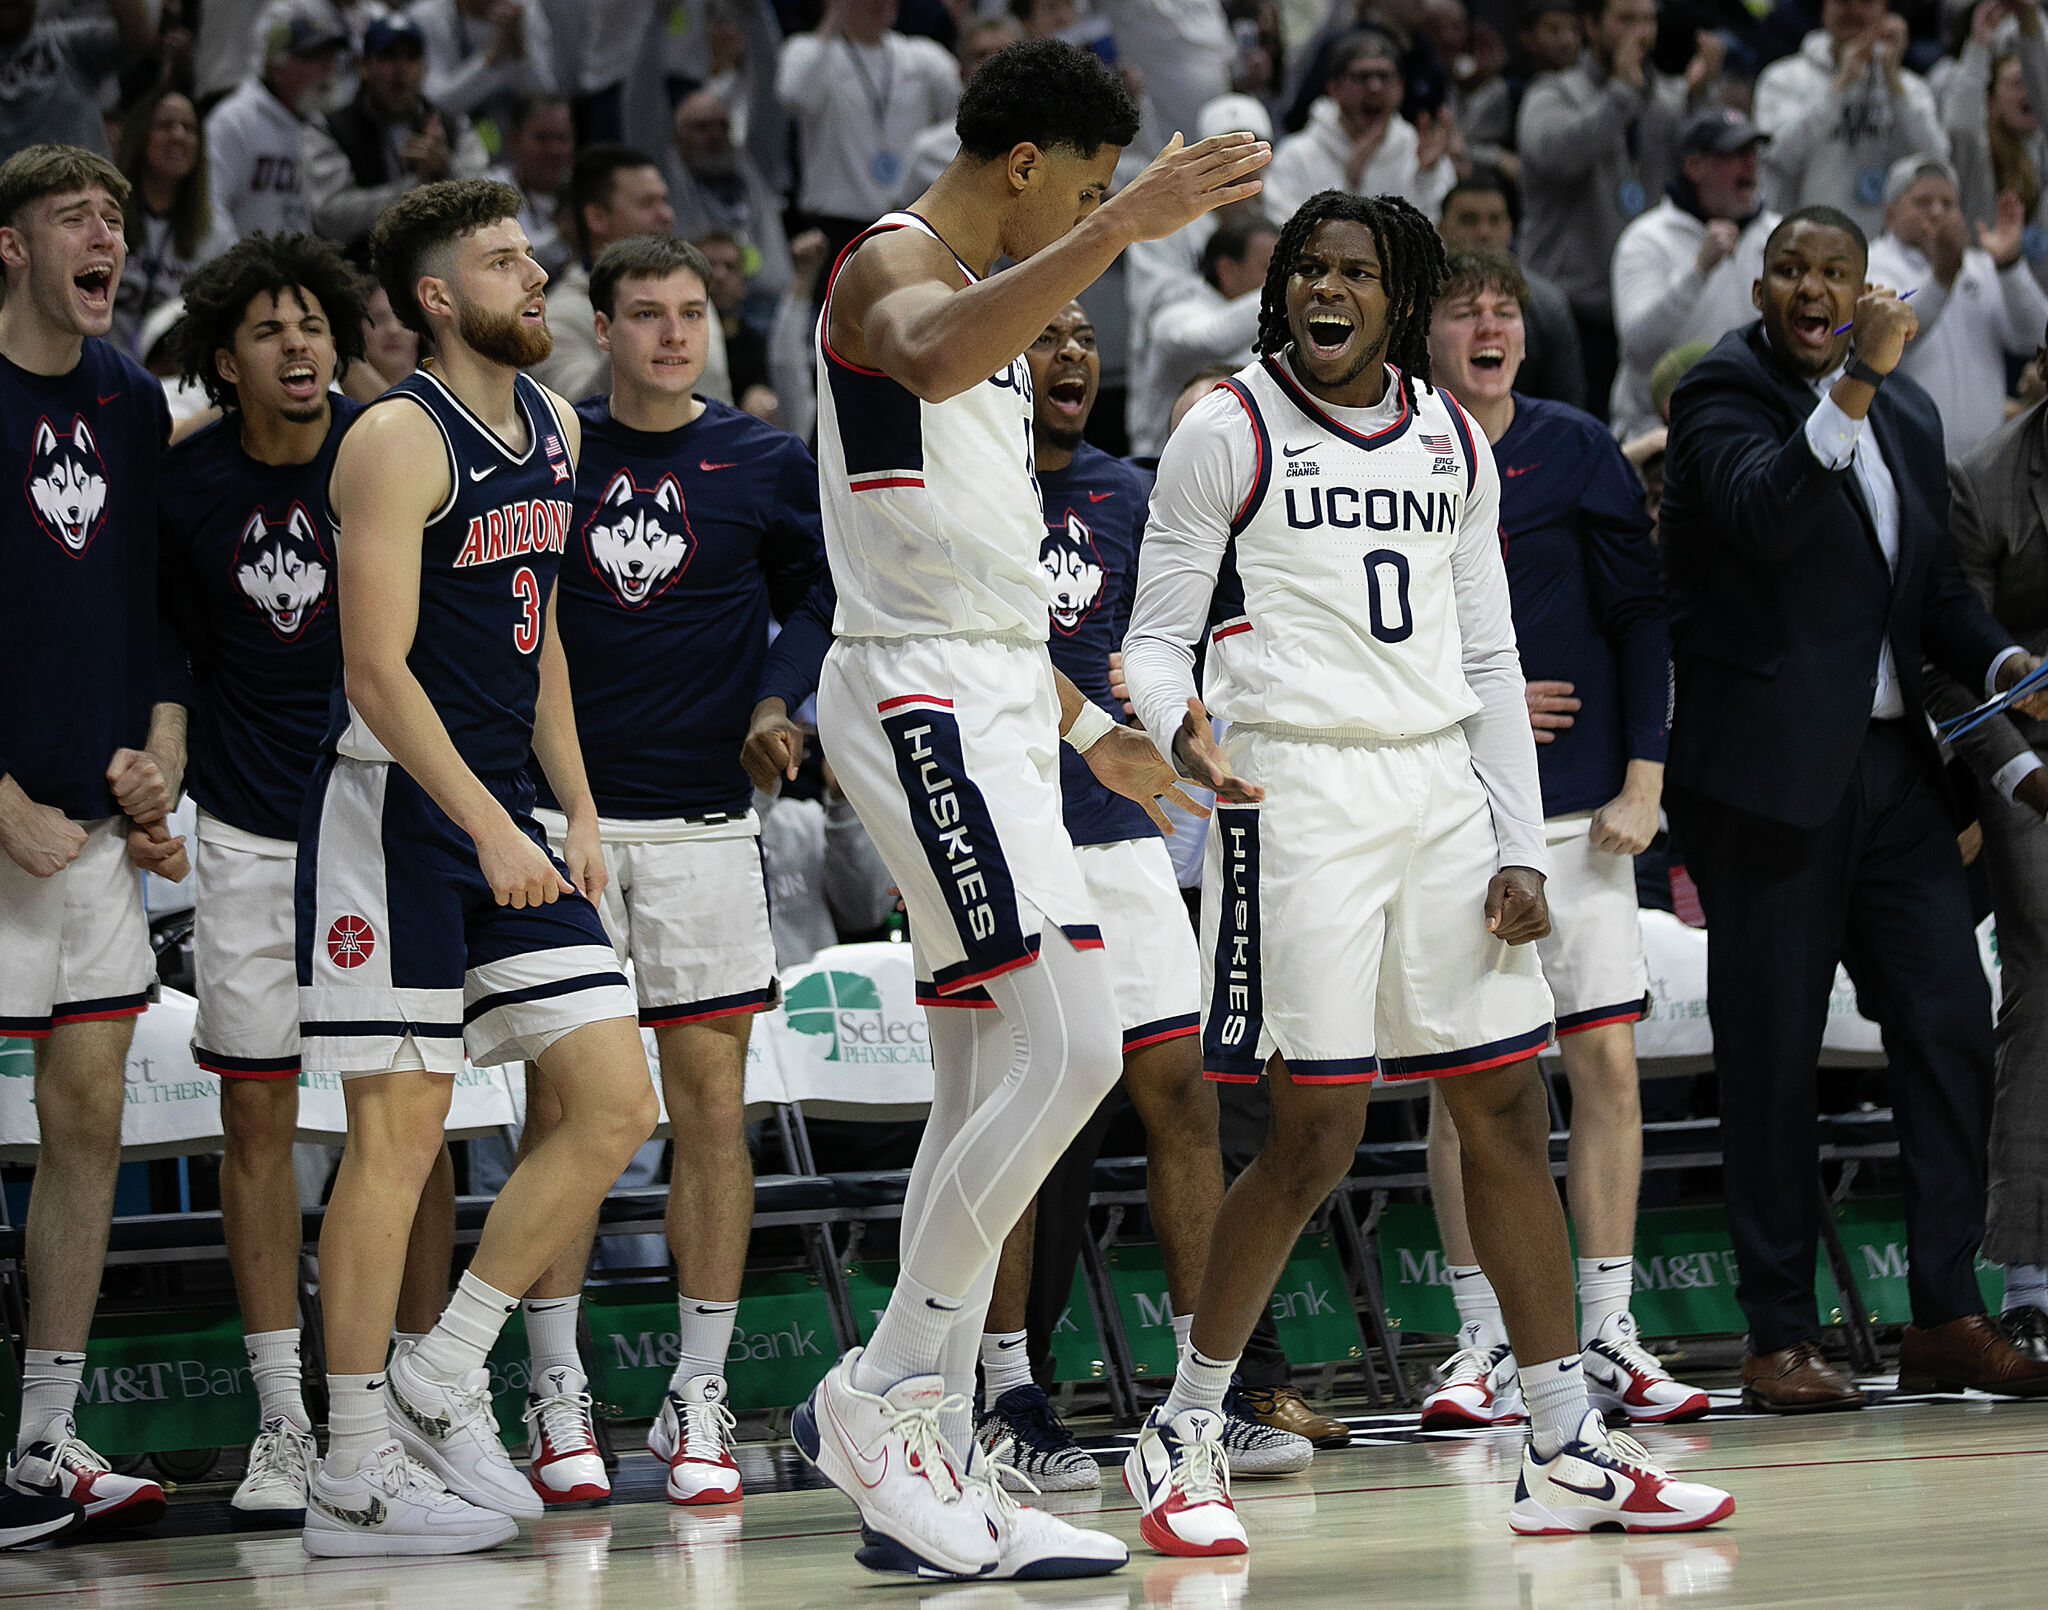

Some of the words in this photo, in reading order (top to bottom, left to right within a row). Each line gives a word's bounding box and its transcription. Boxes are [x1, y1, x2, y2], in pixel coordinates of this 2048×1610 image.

[1286, 467, 1320, 477] CHANGE
[1288, 461, 1299, 469] BE
[1433, 464, 1461, 474] EAST
[1434, 457, 1455, 466] BIG
[1285, 487, 1458, 535] UCONN
[512, 566, 540, 654] 3
[1363, 549, 1413, 643] 0
[904, 724, 996, 942] HUSKIES
[339, 931, 360, 952] A
[1221, 827, 1249, 1046] HUSKIES
[839, 1011, 926, 1045] Selec
[844, 1047, 933, 1063] PHYSICAL
[148, 1080, 222, 1104] THERA
[1272, 1281, 1336, 1320] ank
[609, 1331, 682, 1370] M&
[177, 1360, 251, 1398] Ban
